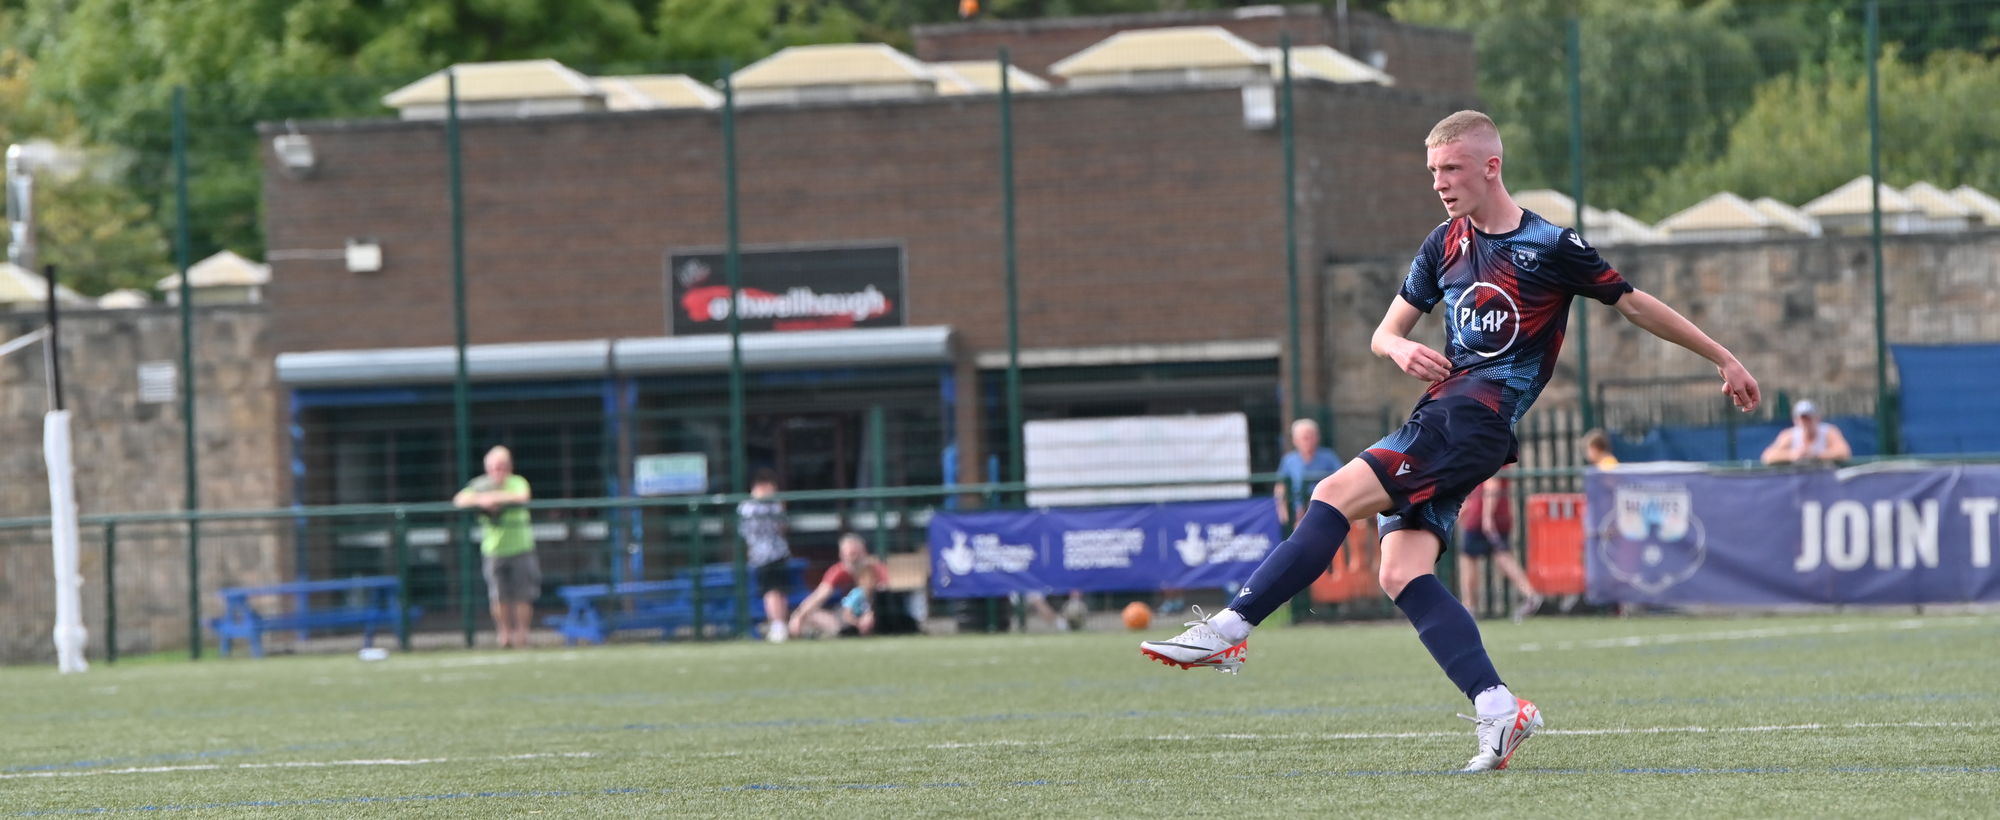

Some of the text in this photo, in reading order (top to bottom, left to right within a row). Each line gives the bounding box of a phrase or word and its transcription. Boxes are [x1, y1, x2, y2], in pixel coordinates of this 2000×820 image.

[1460, 307, 1509, 333] PLAY
[1794, 497, 2000, 572] JOIN T
